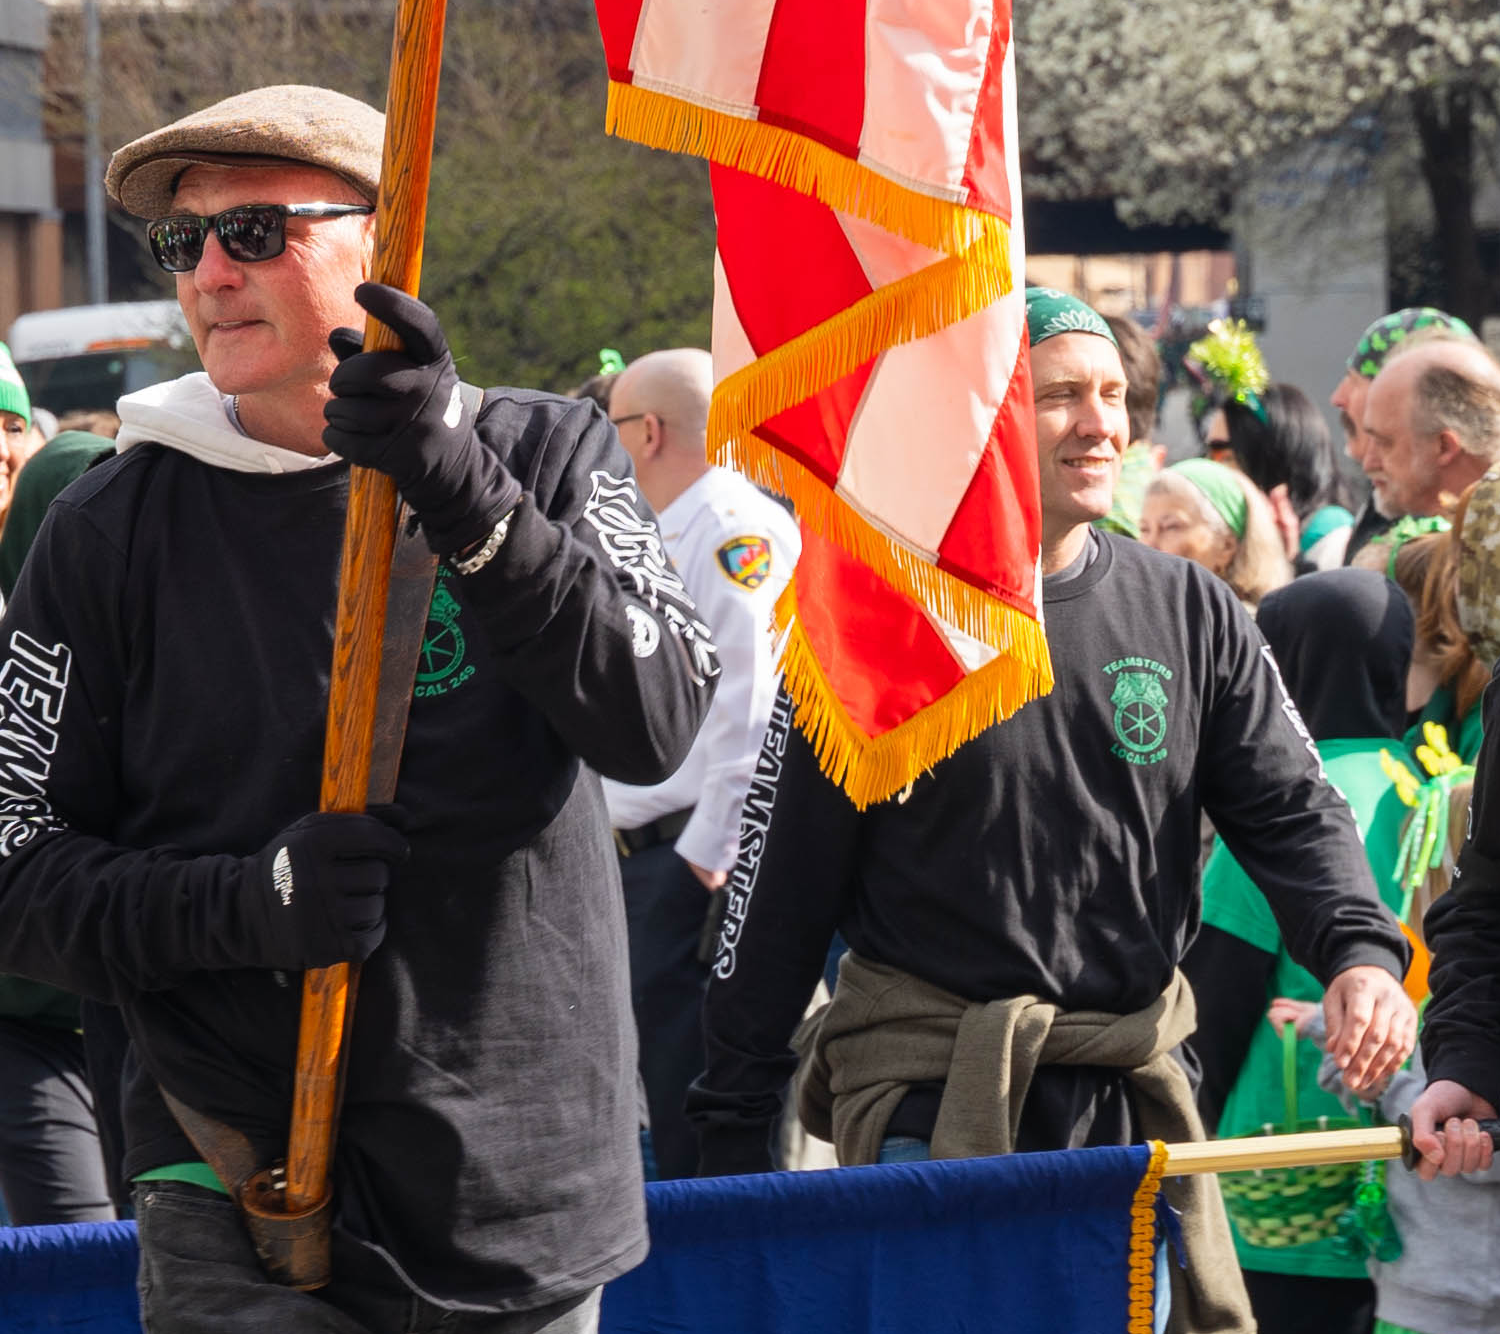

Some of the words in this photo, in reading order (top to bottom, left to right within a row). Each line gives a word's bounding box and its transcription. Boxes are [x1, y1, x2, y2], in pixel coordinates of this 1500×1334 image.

[414, 682, 448, 698] CAL
[449, 664, 476, 689] 249
[1102, 656, 1173, 681] TEAMSTERS
[1110, 743, 1147, 766] LOCAL
